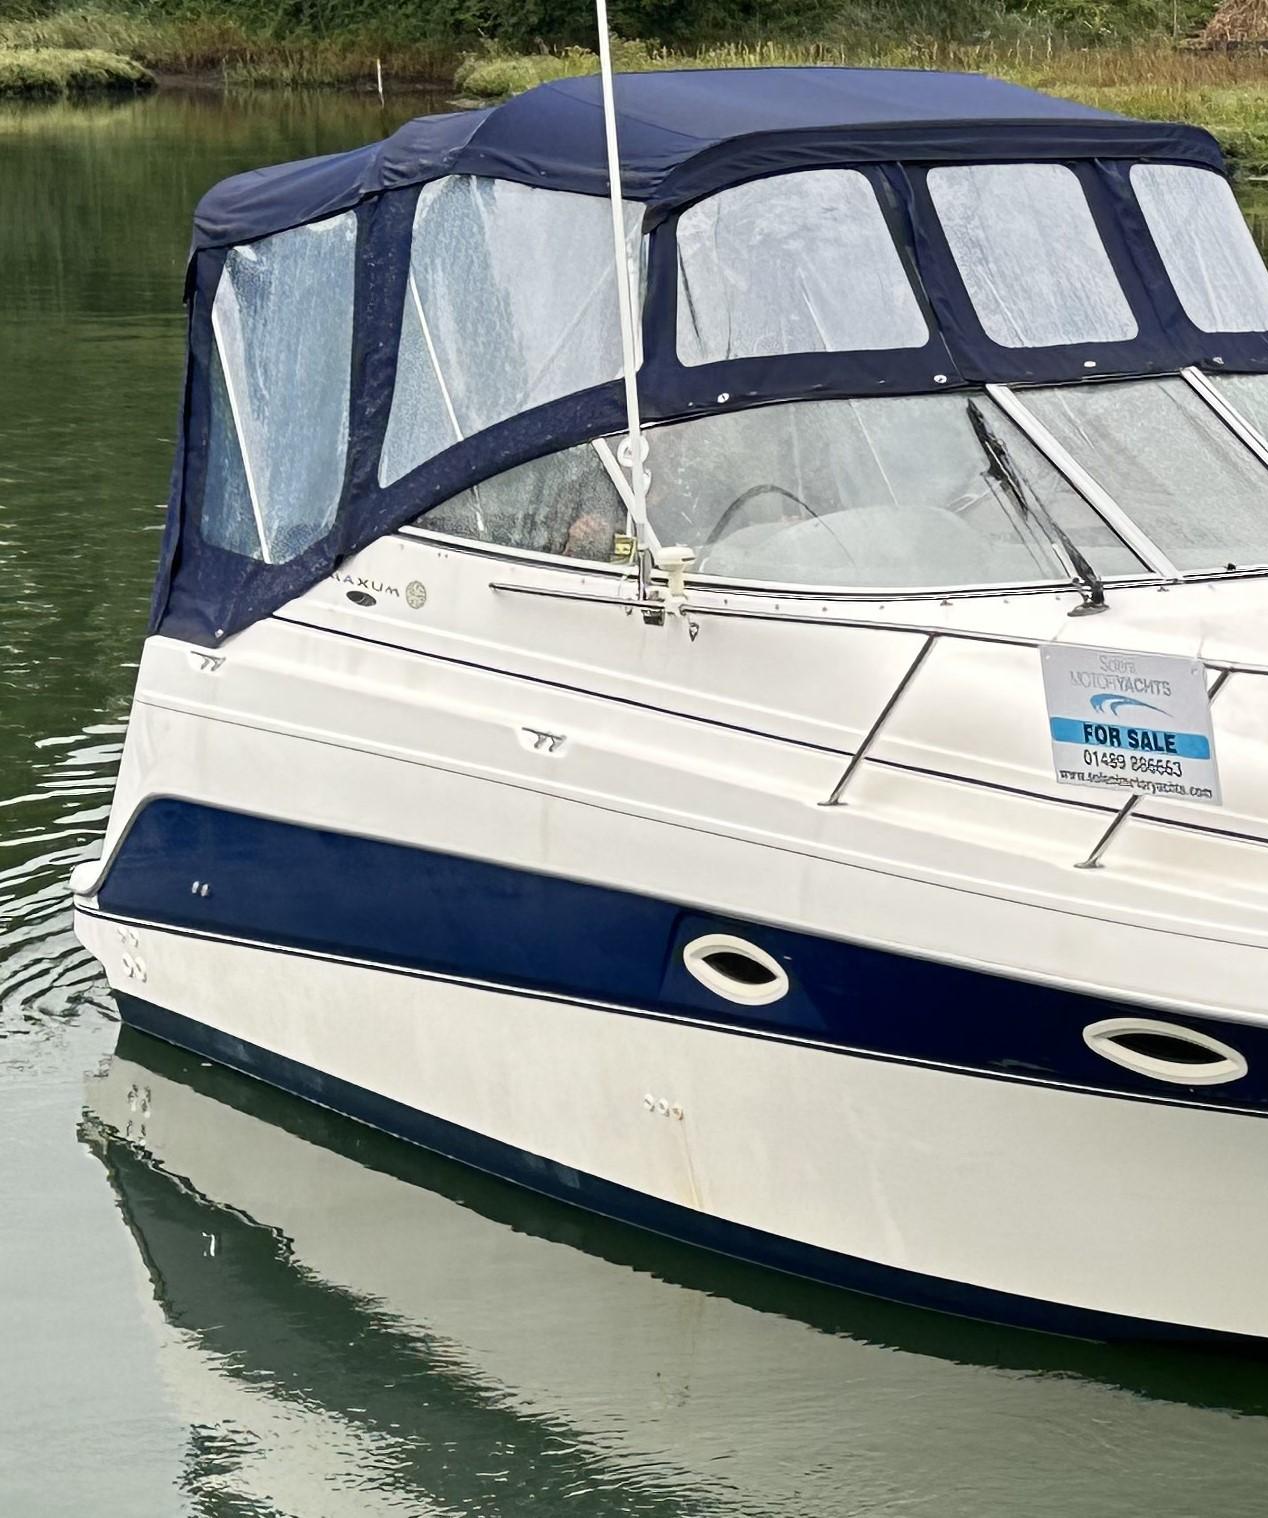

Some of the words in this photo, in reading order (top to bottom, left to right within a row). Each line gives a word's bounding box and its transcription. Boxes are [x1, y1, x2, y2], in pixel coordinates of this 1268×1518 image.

[1083, 722, 1121, 748] FOR
[1127, 729, 1178, 754] SALE
[1083, 749, 1126, 770] 01489
